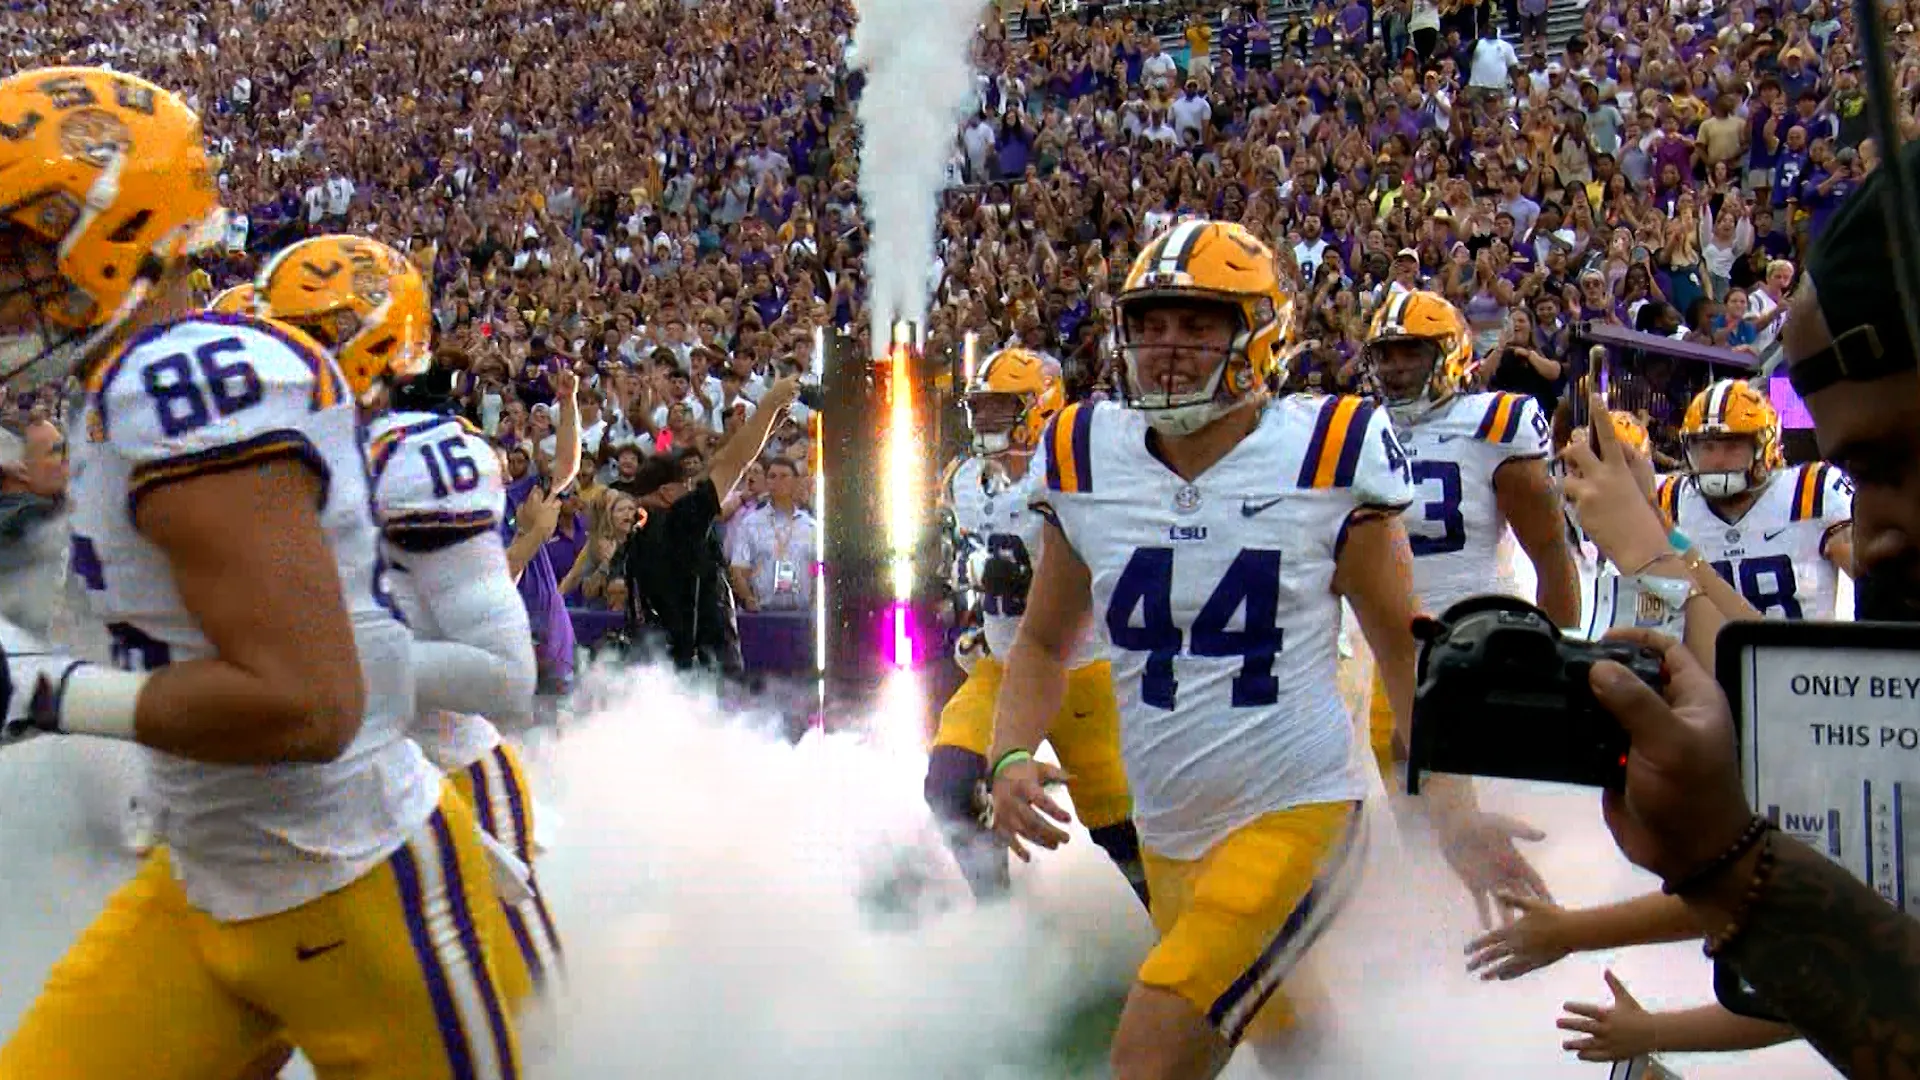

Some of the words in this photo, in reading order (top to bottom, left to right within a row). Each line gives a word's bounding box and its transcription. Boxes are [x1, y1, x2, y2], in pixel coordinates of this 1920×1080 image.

[143, 337, 263, 438] 86
[419, 436, 480, 499] 16
[1410, 459, 1466, 557] 3
[1169, 525, 1208, 541] LSU
[1106, 546, 1284, 711] 44
[1790, 674, 1860, 697] ONLY
[1870, 676, 1920, 700] BEY
[1809, 723, 1870, 748] THIS
[1880, 726, 1919, 750] PO
[1785, 812, 1825, 832] NW
